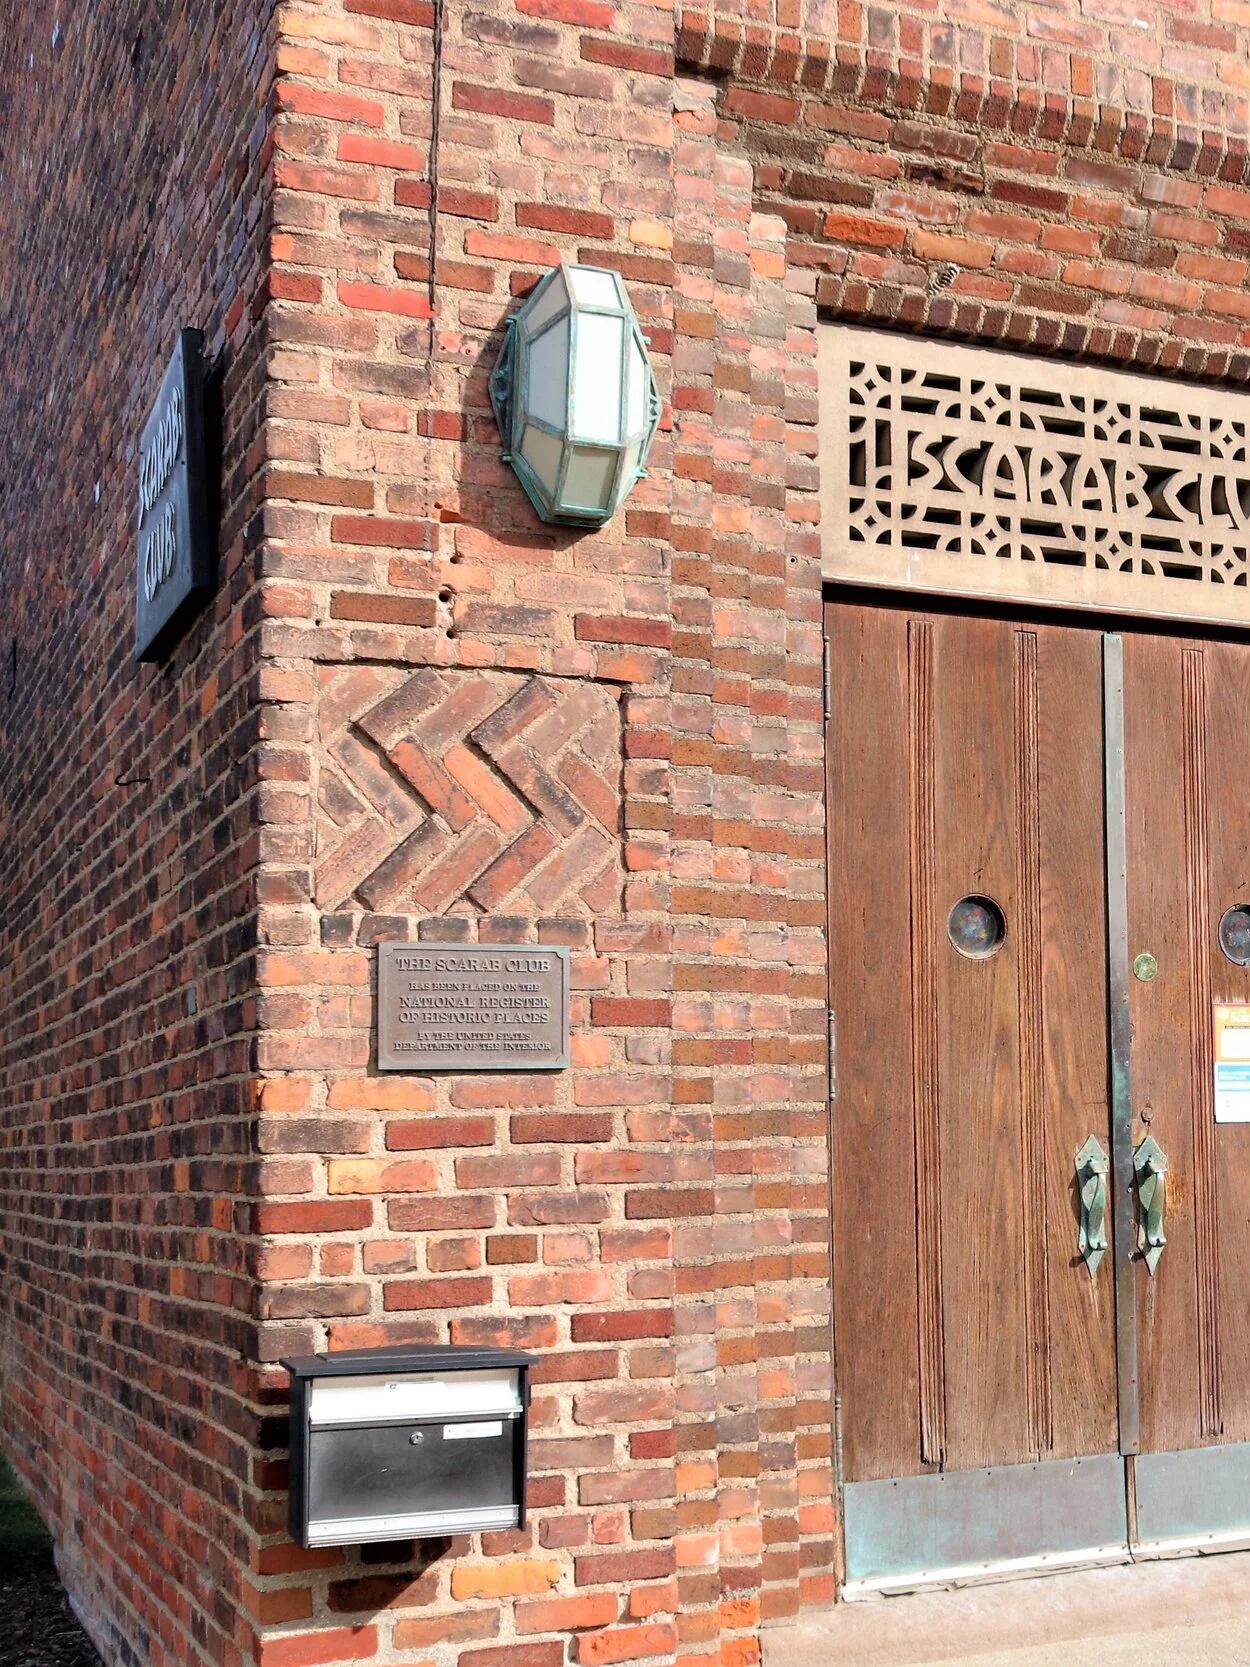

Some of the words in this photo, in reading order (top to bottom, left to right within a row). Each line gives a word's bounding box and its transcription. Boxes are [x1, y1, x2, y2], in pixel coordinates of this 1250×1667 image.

[908, 428, 1153, 519] SCARAB
[395, 957, 431, 971] THE
[435, 957, 501, 973] SCARAB
[505, 959, 551, 974] CLUB
[408, 982, 430, 991] HAS
[432, 982, 459, 992] BEEN
[461, 982, 501, 992] PLACED
[503, 983, 517, 992] ON
[519, 983, 540, 993] THE
[399, 996, 476, 1009] NATIONAL
[479, 997, 550, 1009] REGISTER
[399, 1012, 419, 1024] OF
[422, 1012, 491, 1024] HISTORIC
[493, 1012, 549, 1024] PLACES
[417, 1032, 430, 1041] BY
[432, 1032, 454, 1041] THE
[456, 1032, 494, 1041] UNITED
[496, 1032, 532, 1041] STATES
[393, 1042, 463, 1051] DEPARTMENT
[464, 1042, 477, 1051] OF
[478, 1042, 500, 1051] THE
[503, 1042, 552, 1052] INTERIOR
